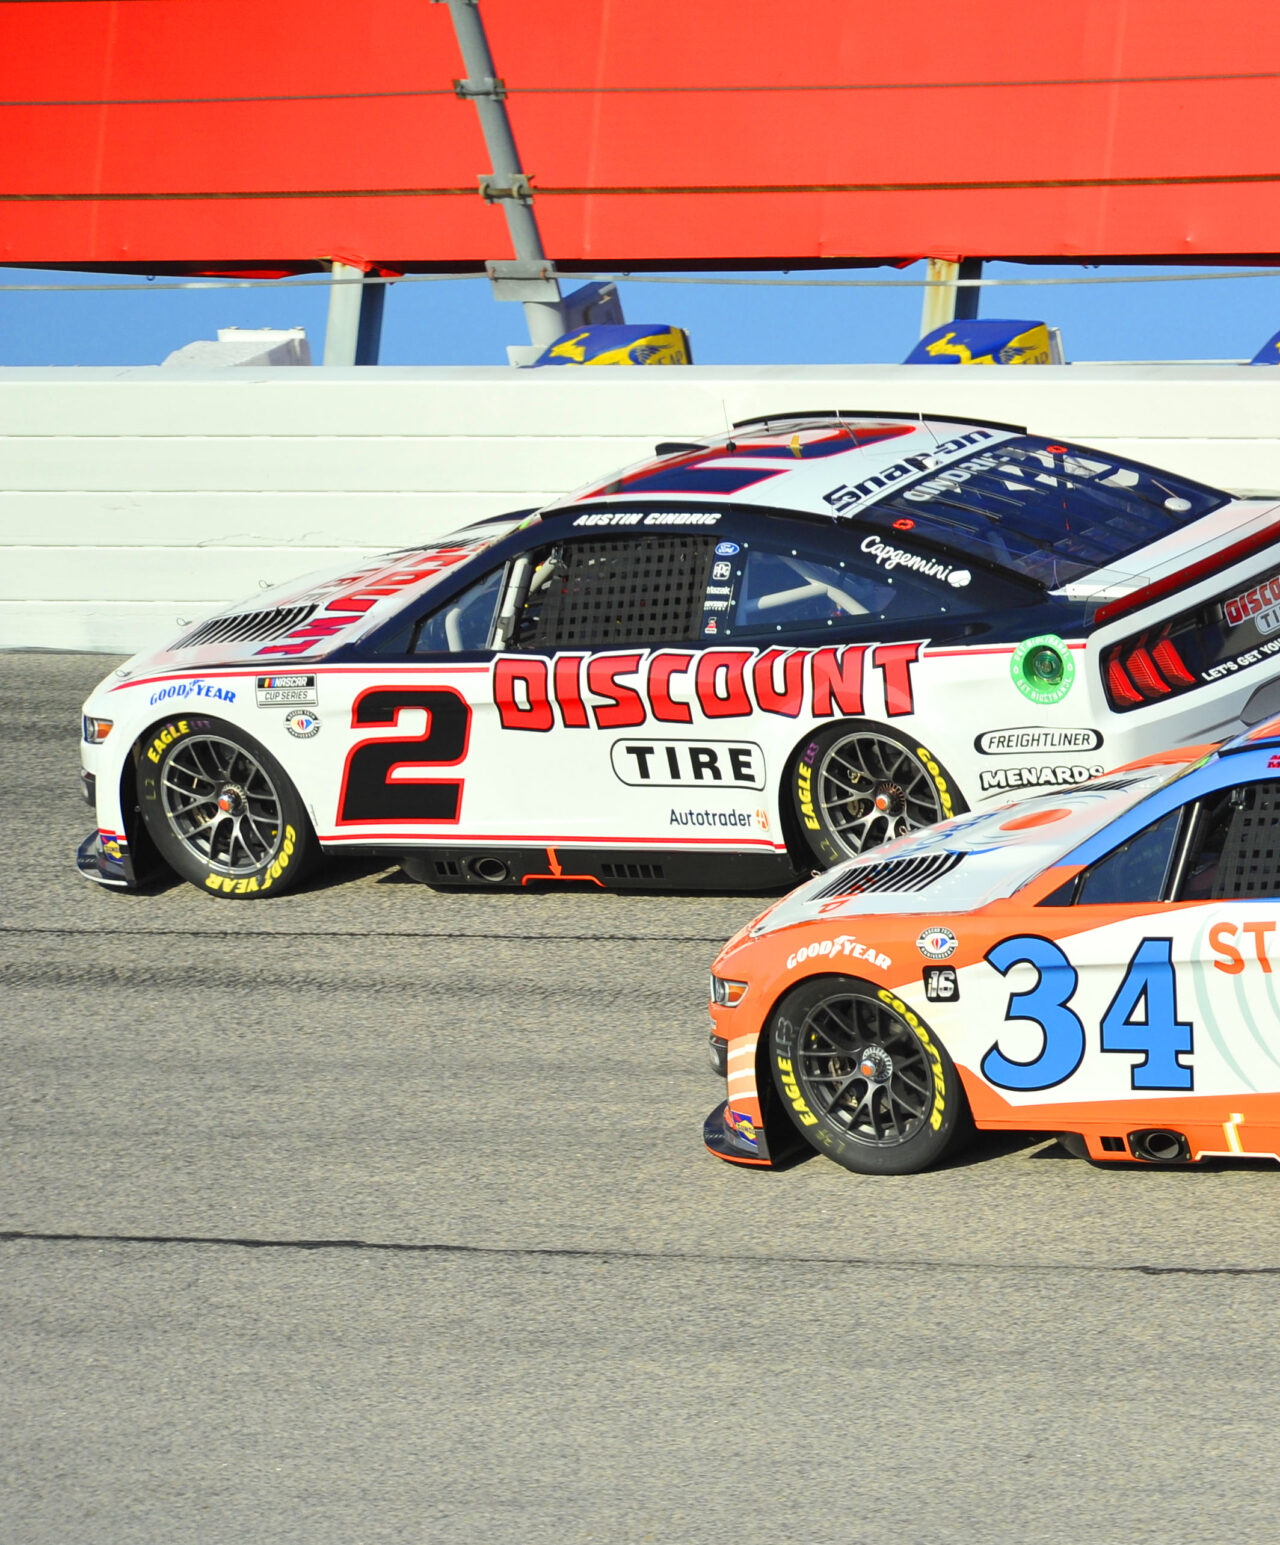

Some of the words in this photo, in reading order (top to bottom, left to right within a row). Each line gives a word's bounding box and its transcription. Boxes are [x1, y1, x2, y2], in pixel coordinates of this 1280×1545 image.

[572, 513, 643, 527] AUSTIN
[643, 513, 722, 526] CINDRIC
[861, 536, 953, 582] Capgemini
[275, 677, 308, 688] NASCAR
[1201, 660, 1239, 682] LET'S
[1238, 645, 1264, 668] GET
[150, 680, 236, 706] GOODYEAR
[265, 691, 284, 701] CUP
[286, 690, 308, 701] SERIES
[493, 643, 923, 732] DISCOUNT
[147, 720, 190, 764] EAGLE
[336, 685, 472, 825] 2
[988, 732, 1091, 749] FREIGHTLINER
[625, 745, 757, 783] TIRE
[979, 765, 1105, 791] MENARDS
[803, 762, 822, 831] EAGLE
[669, 808, 753, 827] Autotrader
[204, 823, 297, 895] GOODYEAR
[786, 934, 892, 971] GOODYEAR
[979, 933, 1197, 1092] 34
[877, 988, 947, 1132] GOODYEAR
[777, 1056, 819, 1127] EAGLE
